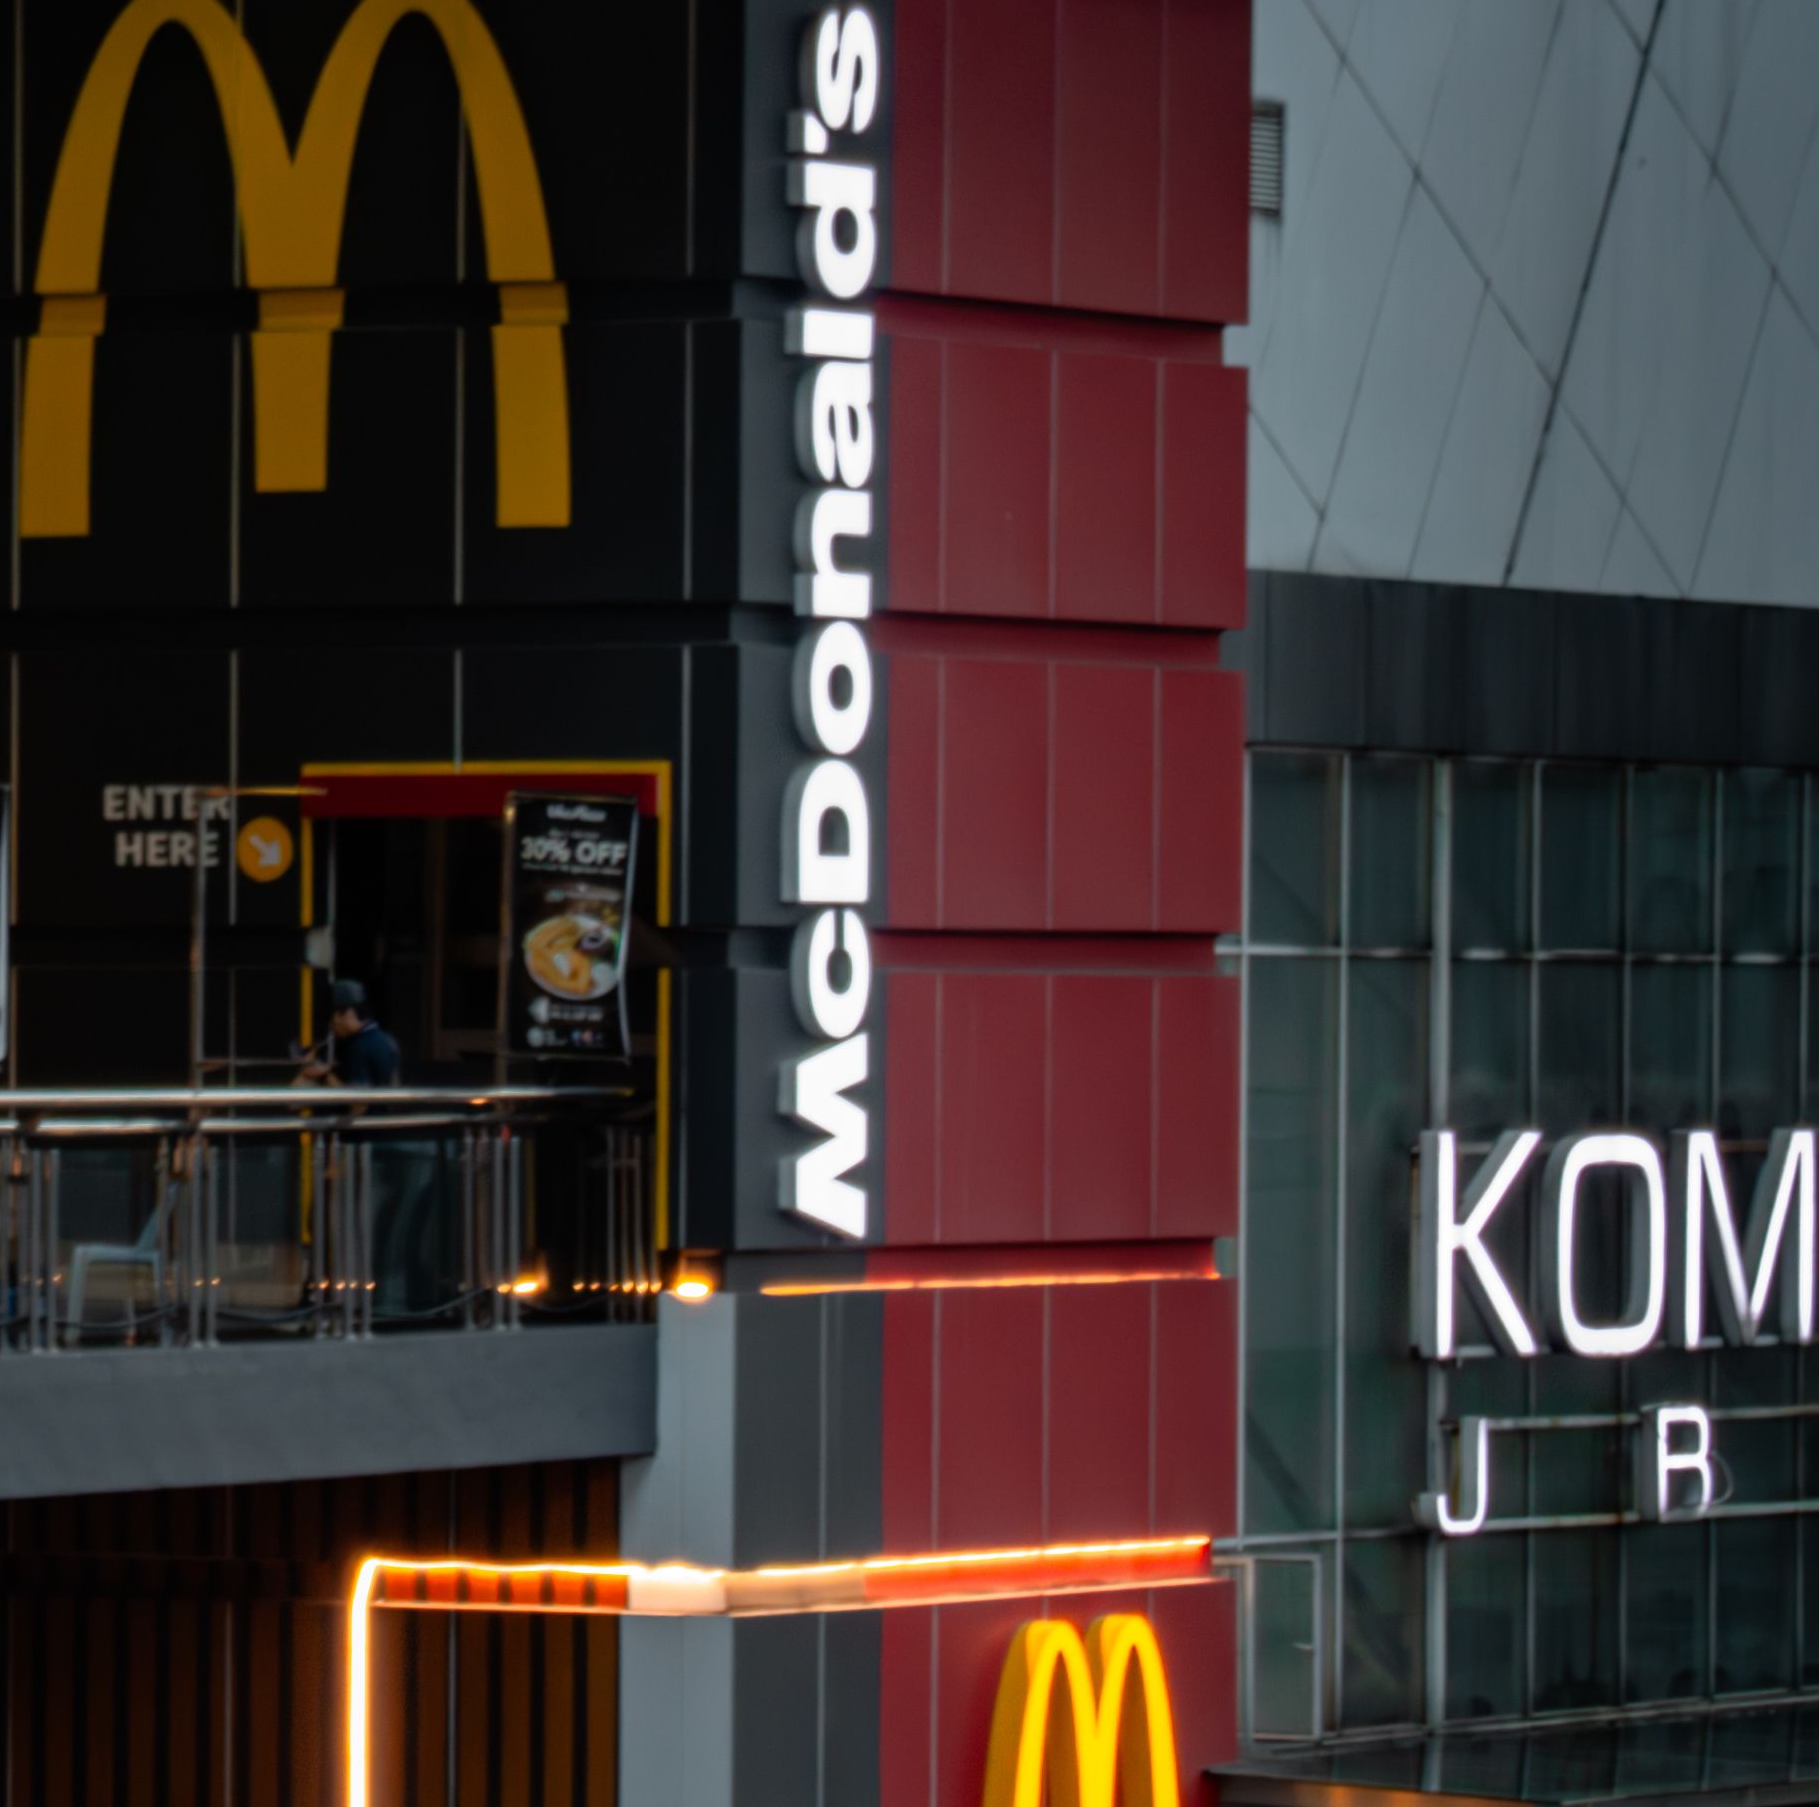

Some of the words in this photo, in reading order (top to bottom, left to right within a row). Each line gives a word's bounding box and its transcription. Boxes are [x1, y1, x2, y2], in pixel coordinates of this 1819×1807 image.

[791, 4, 880, 1241] McDonald's
[102, 783, 232, 822] ENTER
[114, 831, 221, 868] HERE
[520, 835, 571, 863] 30%
[575, 838, 628, 867] OFF
[1436, 1128, 1816, 1359] KOM
